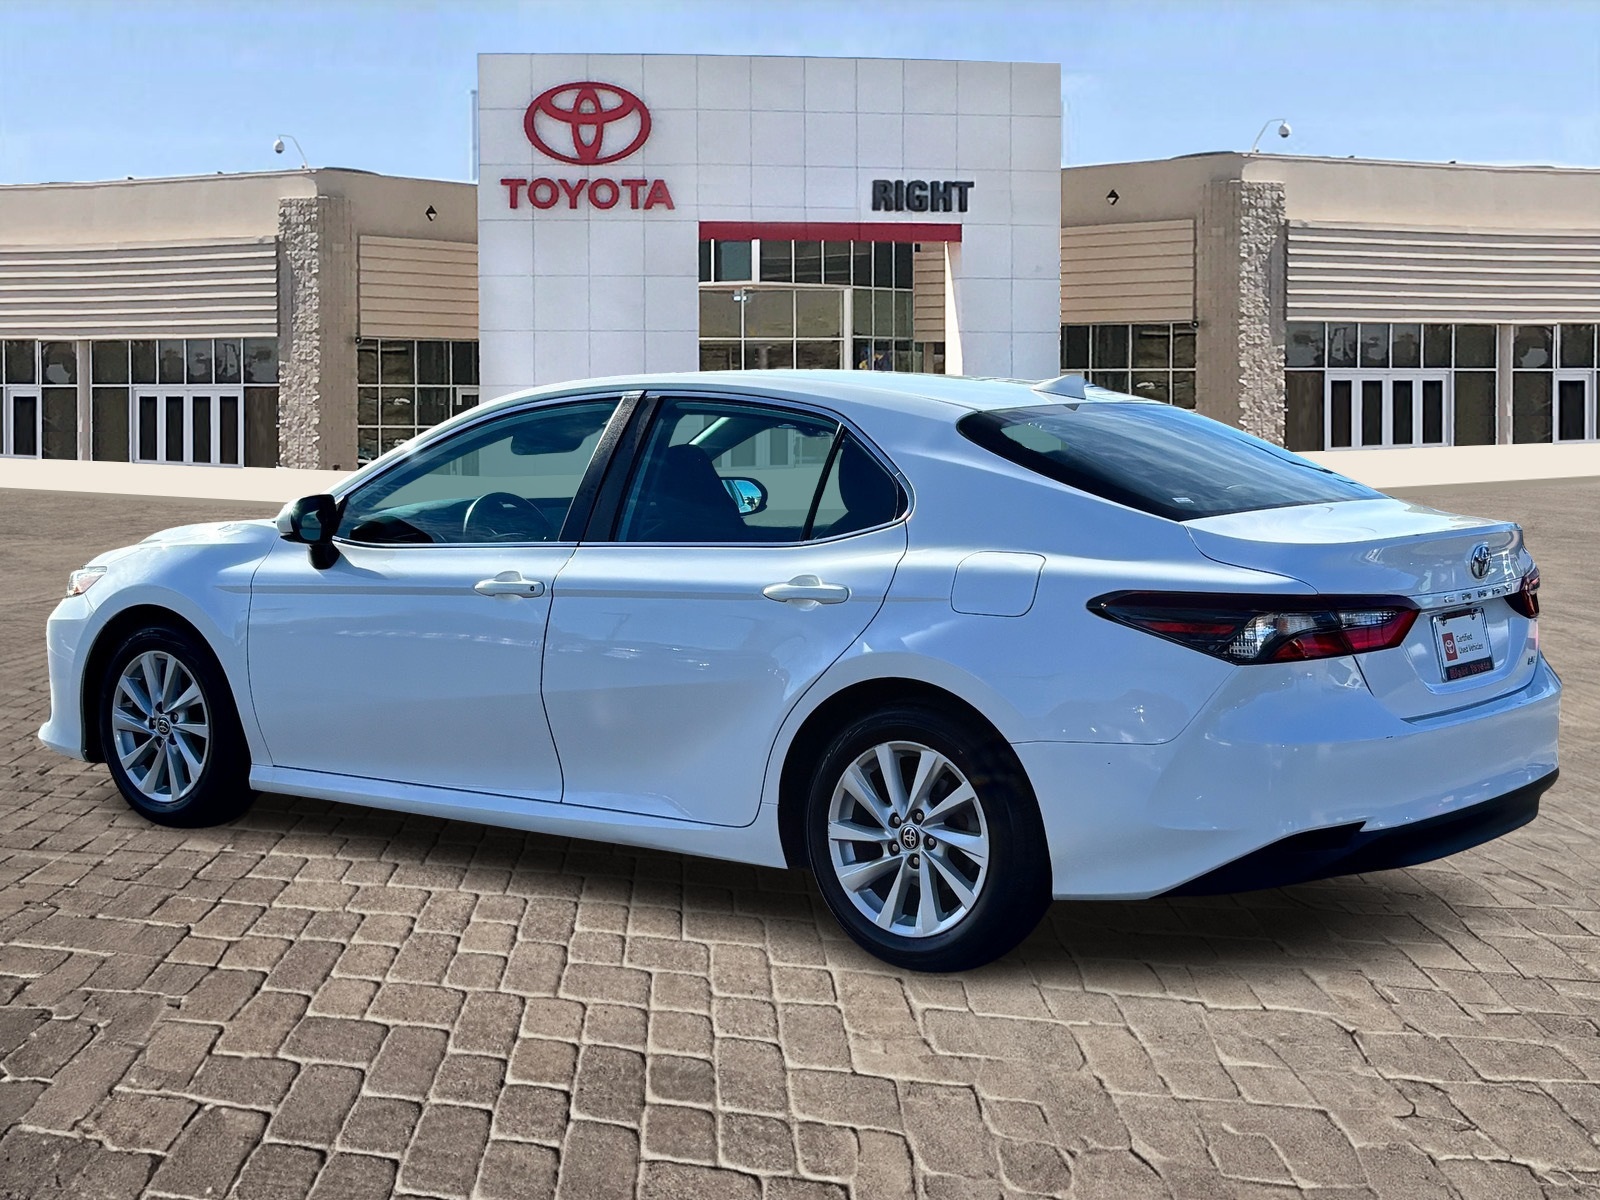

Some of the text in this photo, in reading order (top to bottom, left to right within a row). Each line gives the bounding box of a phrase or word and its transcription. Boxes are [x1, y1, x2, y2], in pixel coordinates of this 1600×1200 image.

[500, 178, 675, 209] TOYOTA
[872, 179, 975, 212] RIGHT
[1456, 633, 1473, 643] Certified
